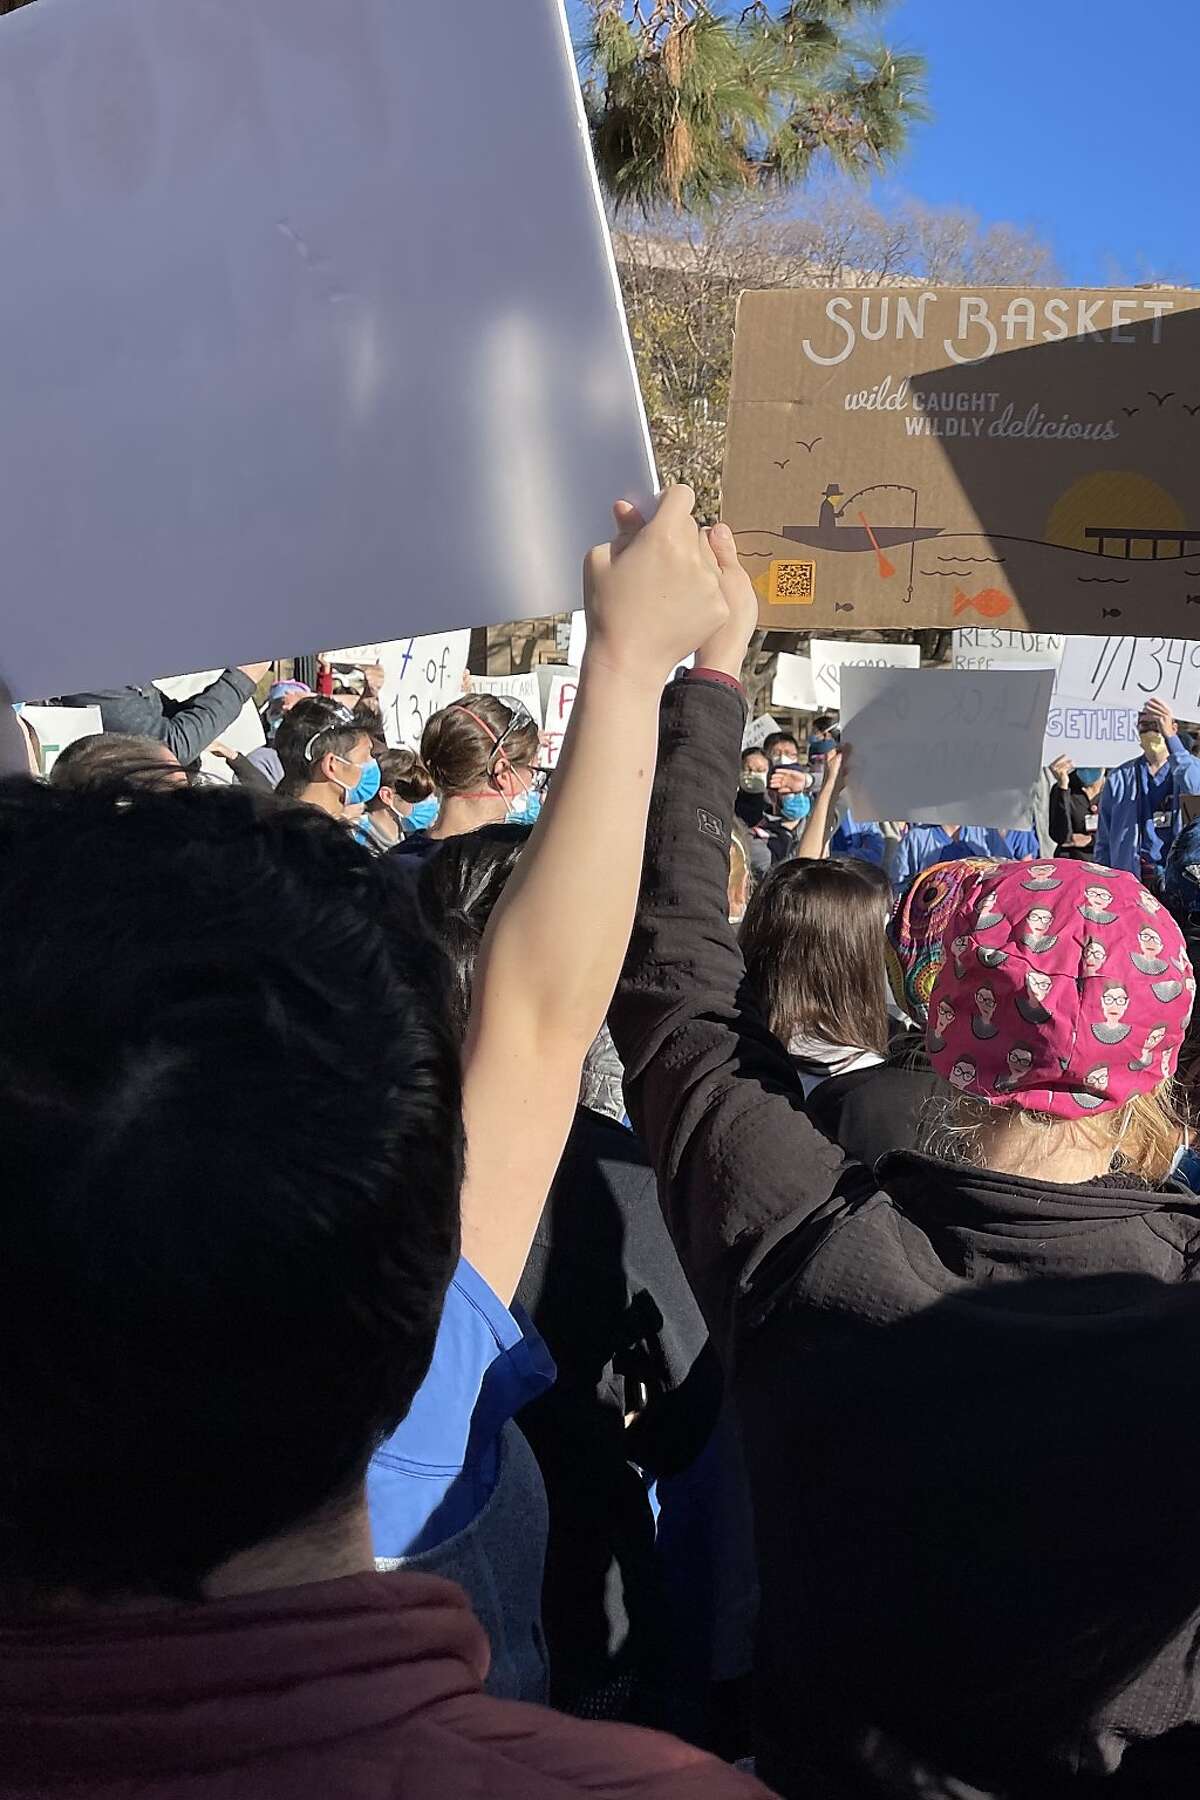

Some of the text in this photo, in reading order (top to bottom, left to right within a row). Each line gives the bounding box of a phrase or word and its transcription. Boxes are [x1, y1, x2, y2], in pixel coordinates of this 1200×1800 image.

[802, 292, 1175, 366] SUN BASKET
[844, 374, 1000, 413] wild CAUGHT
[905, 402, 1119, 442] WILDLY delicious
